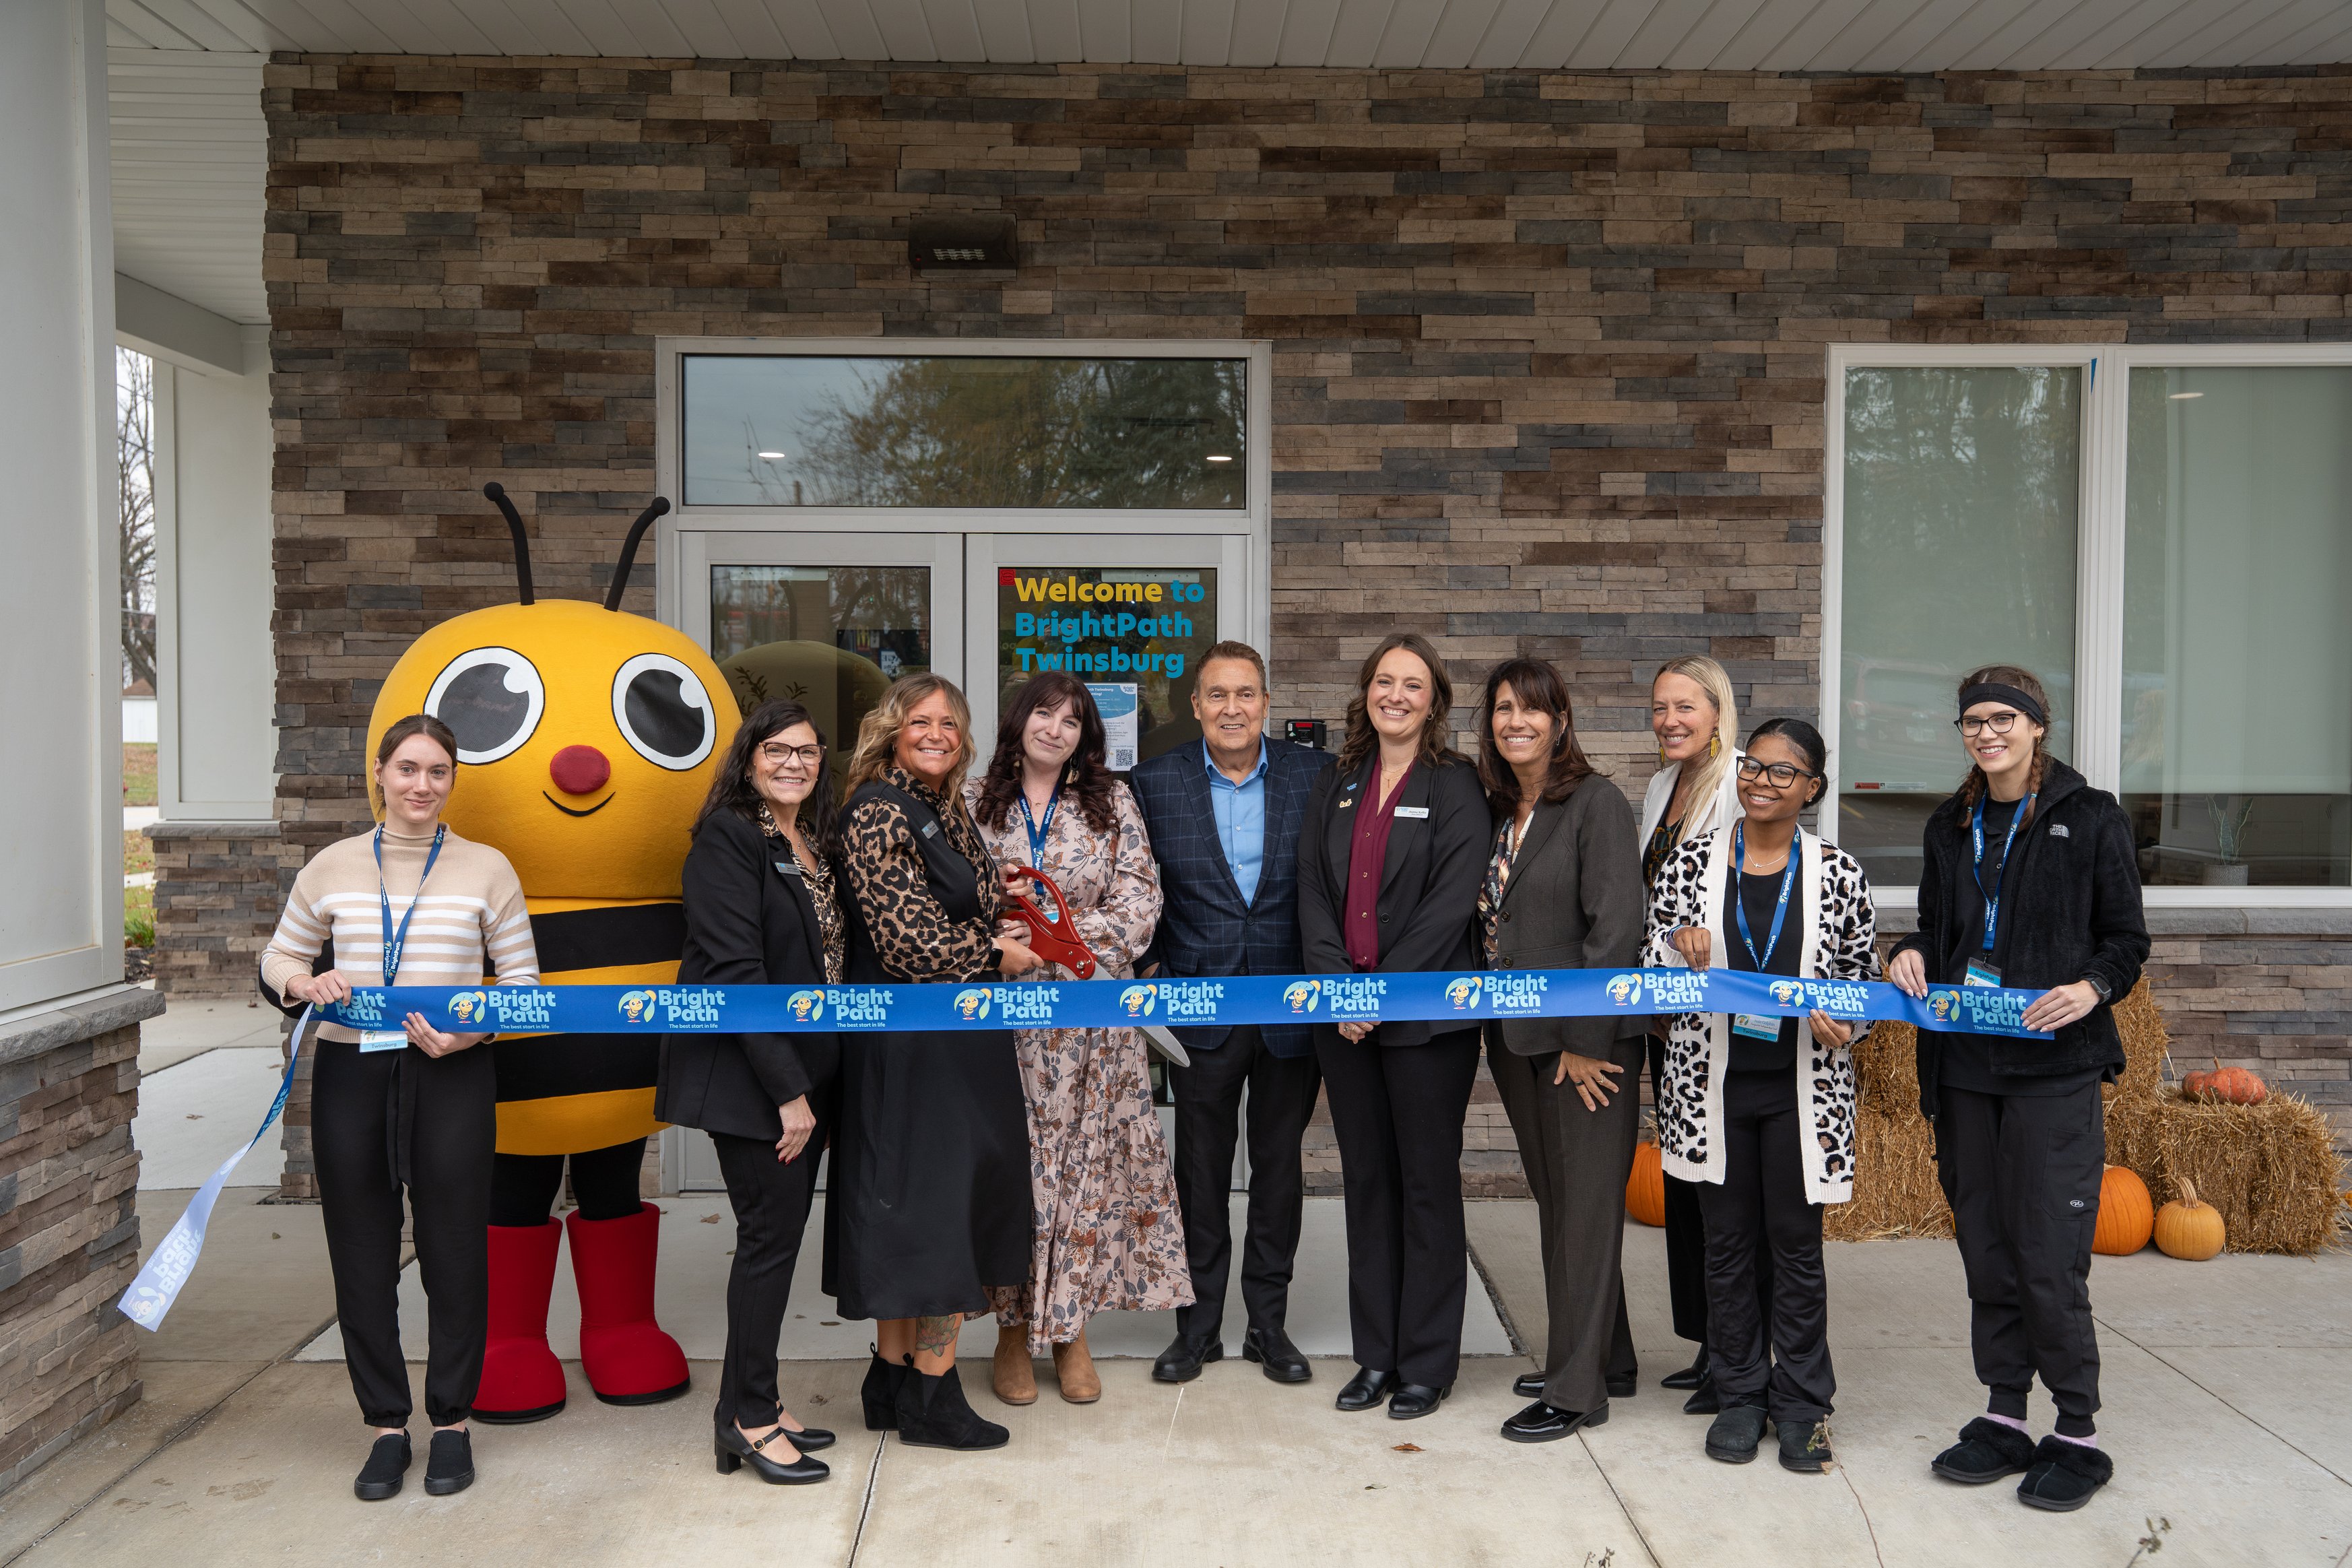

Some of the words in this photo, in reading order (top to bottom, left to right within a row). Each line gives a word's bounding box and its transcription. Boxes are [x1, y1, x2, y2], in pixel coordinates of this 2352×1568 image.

[1014, 577, 1163, 602] Welcome
[1171, 580, 1205, 603] to
[1016, 611, 1192, 644] BrightPath
[1016, 647, 1184, 679] Twinsburg
[1782, 872, 1792, 896] BrightPath
[1988, 904, 1996, 932] BrightPath
[391, 942, 401, 969] BrightPath
[1765, 935, 1776, 961] BrightPath
[1484, 974, 1548, 996] Bright
[1644, 971, 1708, 992] Bright
[1975, 971, 1995, 981] BrightPath
[658, 988, 725, 1010] Bright
[826, 988, 893, 1009] Bright
[994, 985, 1059, 1007] Bright
[1159, 981, 1224, 1003] Bright
[1323, 977, 1387, 1000] Bright
[1654, 987, 1703, 1004] Path
[1805, 983, 1869, 1000] Bright
[488, 989, 556, 1011] Bright
[1002, 1002, 1051, 1018] Path
[1167, 998, 1216, 1015] Path
[1331, 994, 1379, 1011] Path
[1493, 991, 1540, 1008] Path
[1816, 995, 1864, 1012] Path
[1961, 991, 2026, 1013] Bright
[335, 1002, 382, 1020] Path
[498, 1006, 550, 1022] Path
[667, 1005, 719, 1022] Path
[836, 1004, 886, 1020] Path
[1971, 1007, 2020, 1026] Path
[1742, 1028, 1768, 1039] Twinsburg
